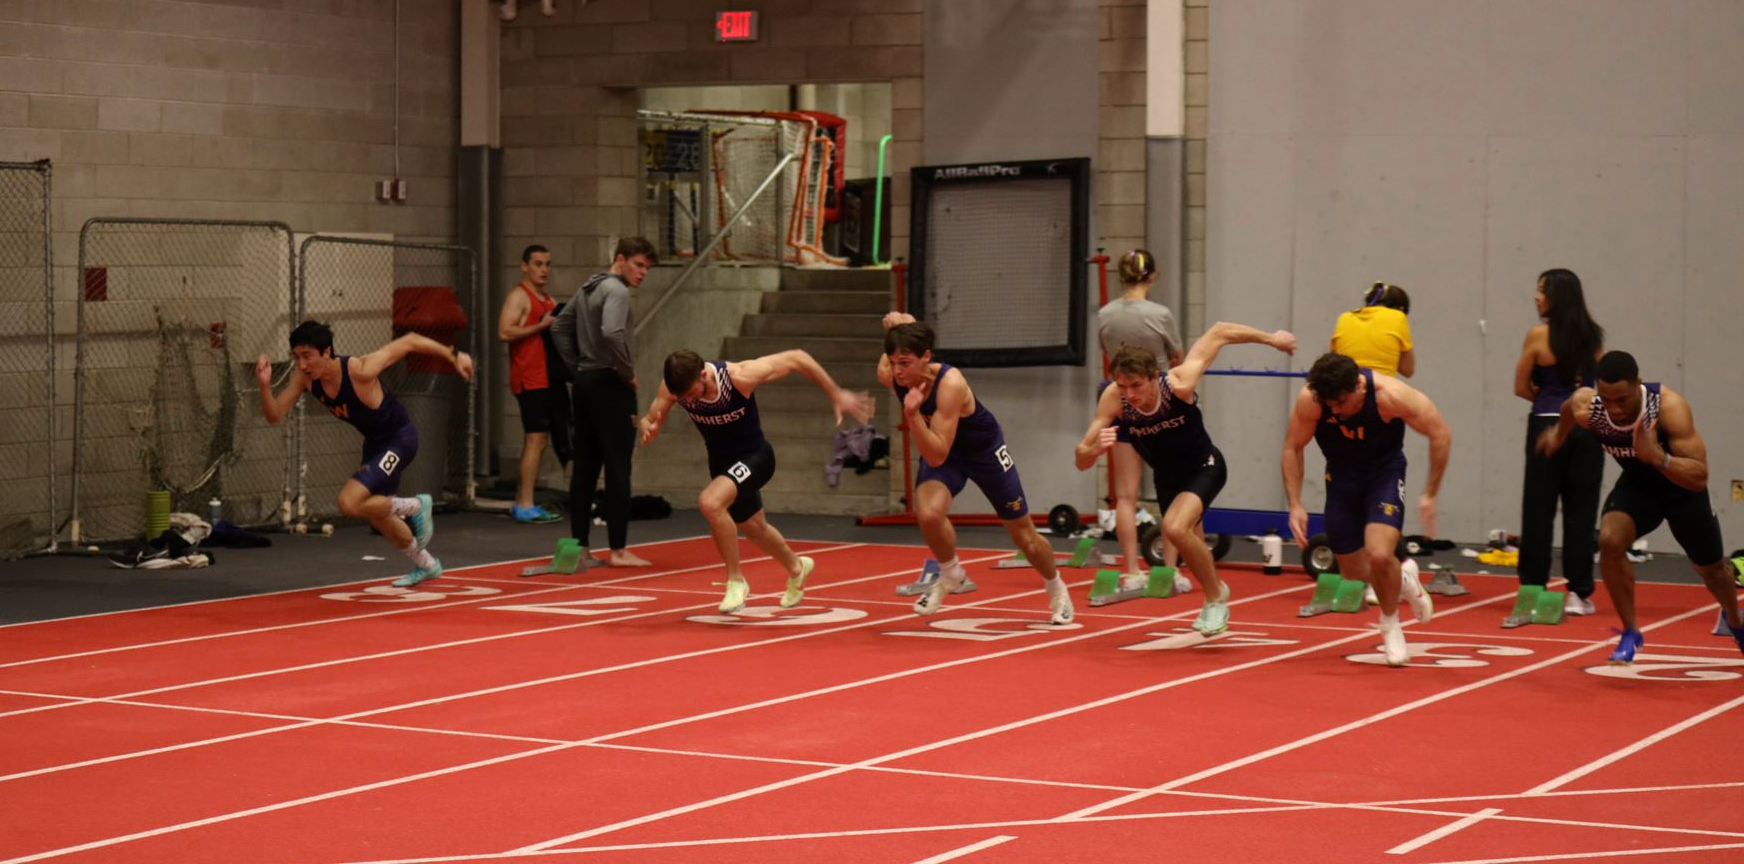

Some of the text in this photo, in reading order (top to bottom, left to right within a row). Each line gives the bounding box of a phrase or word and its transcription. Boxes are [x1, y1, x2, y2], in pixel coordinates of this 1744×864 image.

[721, 11, 752, 38] EXIT
[934, 165, 1022, 180] AllBallPro
[1128, 415, 1186, 437] AMHERST
[383, 454, 397, 472] 8
[999, 449, 1013, 468] 5
[733, 465, 748, 479] 6
[319, 583, 502, 603] 8
[881, 617, 1083, 642] 5
[1116, 627, 1301, 651] 4
[1345, 642, 1535, 667] 3
[1583, 653, 1744, 681] 2
